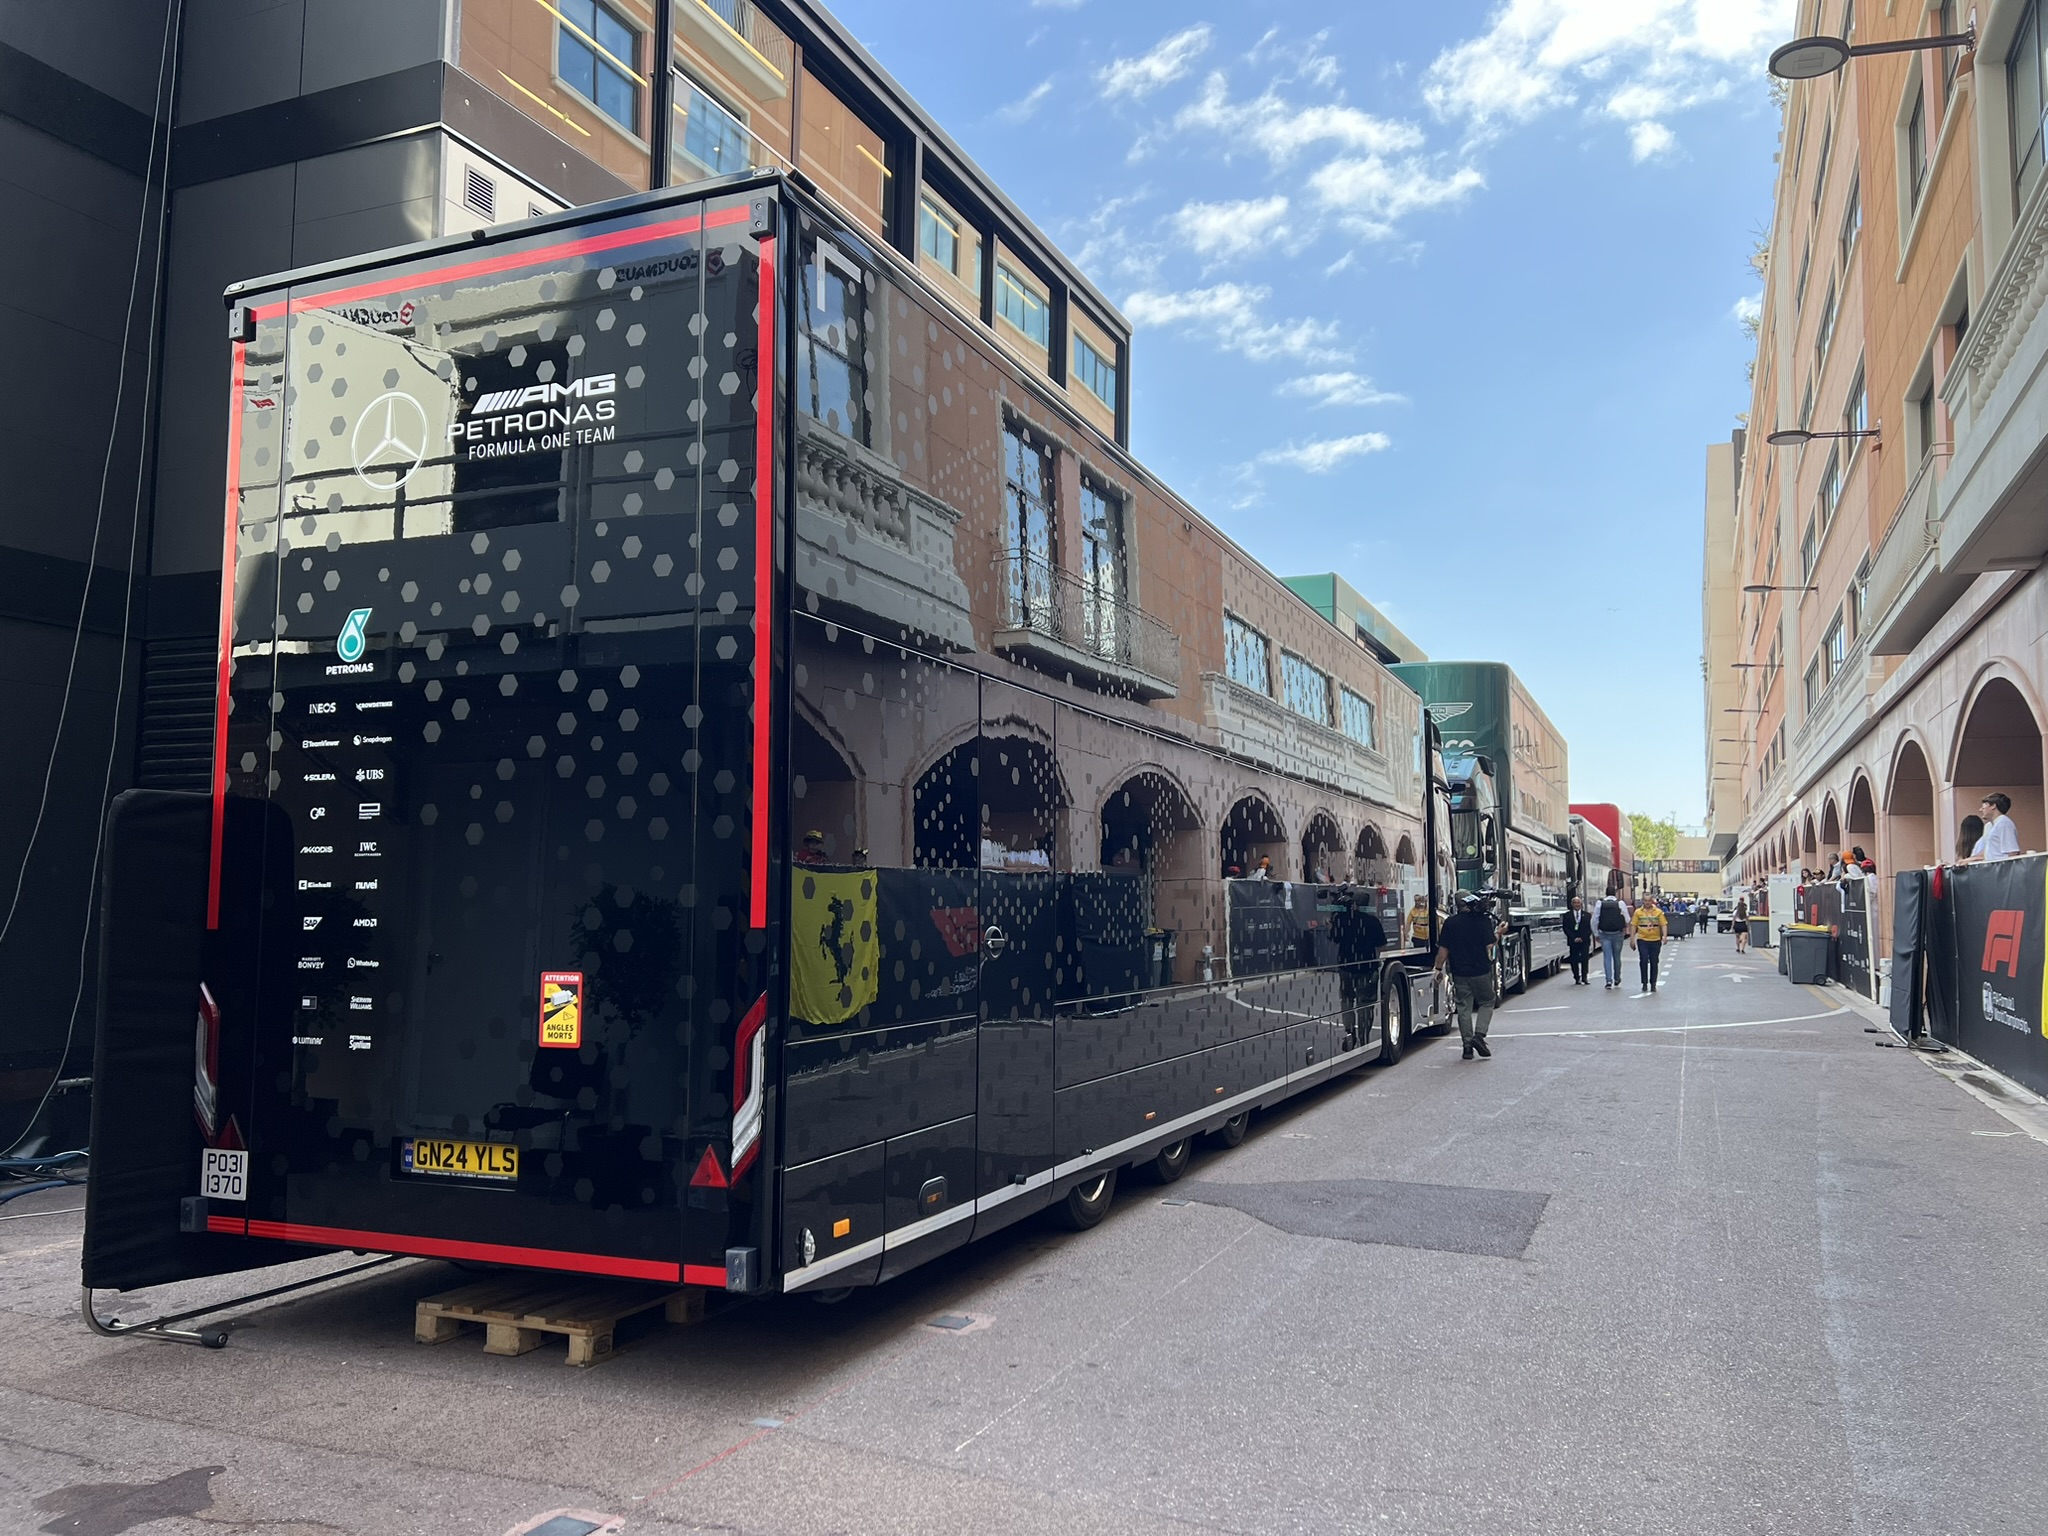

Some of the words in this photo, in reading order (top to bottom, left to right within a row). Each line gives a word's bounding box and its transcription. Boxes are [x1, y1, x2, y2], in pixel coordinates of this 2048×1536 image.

[516, 373, 616, 407] AMG
[447, 399, 616, 443] PETRONAS
[468, 437, 536, 461] FORMULA
[541, 431, 571, 450] ONE
[576, 425, 616, 445] TEAM
[326, 663, 374, 675] PETRONAS
[309, 702, 336, 714] INEOS
[366, 769, 383, 780] UBS
[360, 842, 376, 851] IWC
[356, 879, 377, 889] nuvei
[544, 974, 579, 982] ATTENTION
[546, 1023, 574, 1032] ANGLES
[547, 1031, 573, 1040] MORTS
[416, 1141, 468, 1169] GN24
[474, 1145, 515, 1173] YLS
